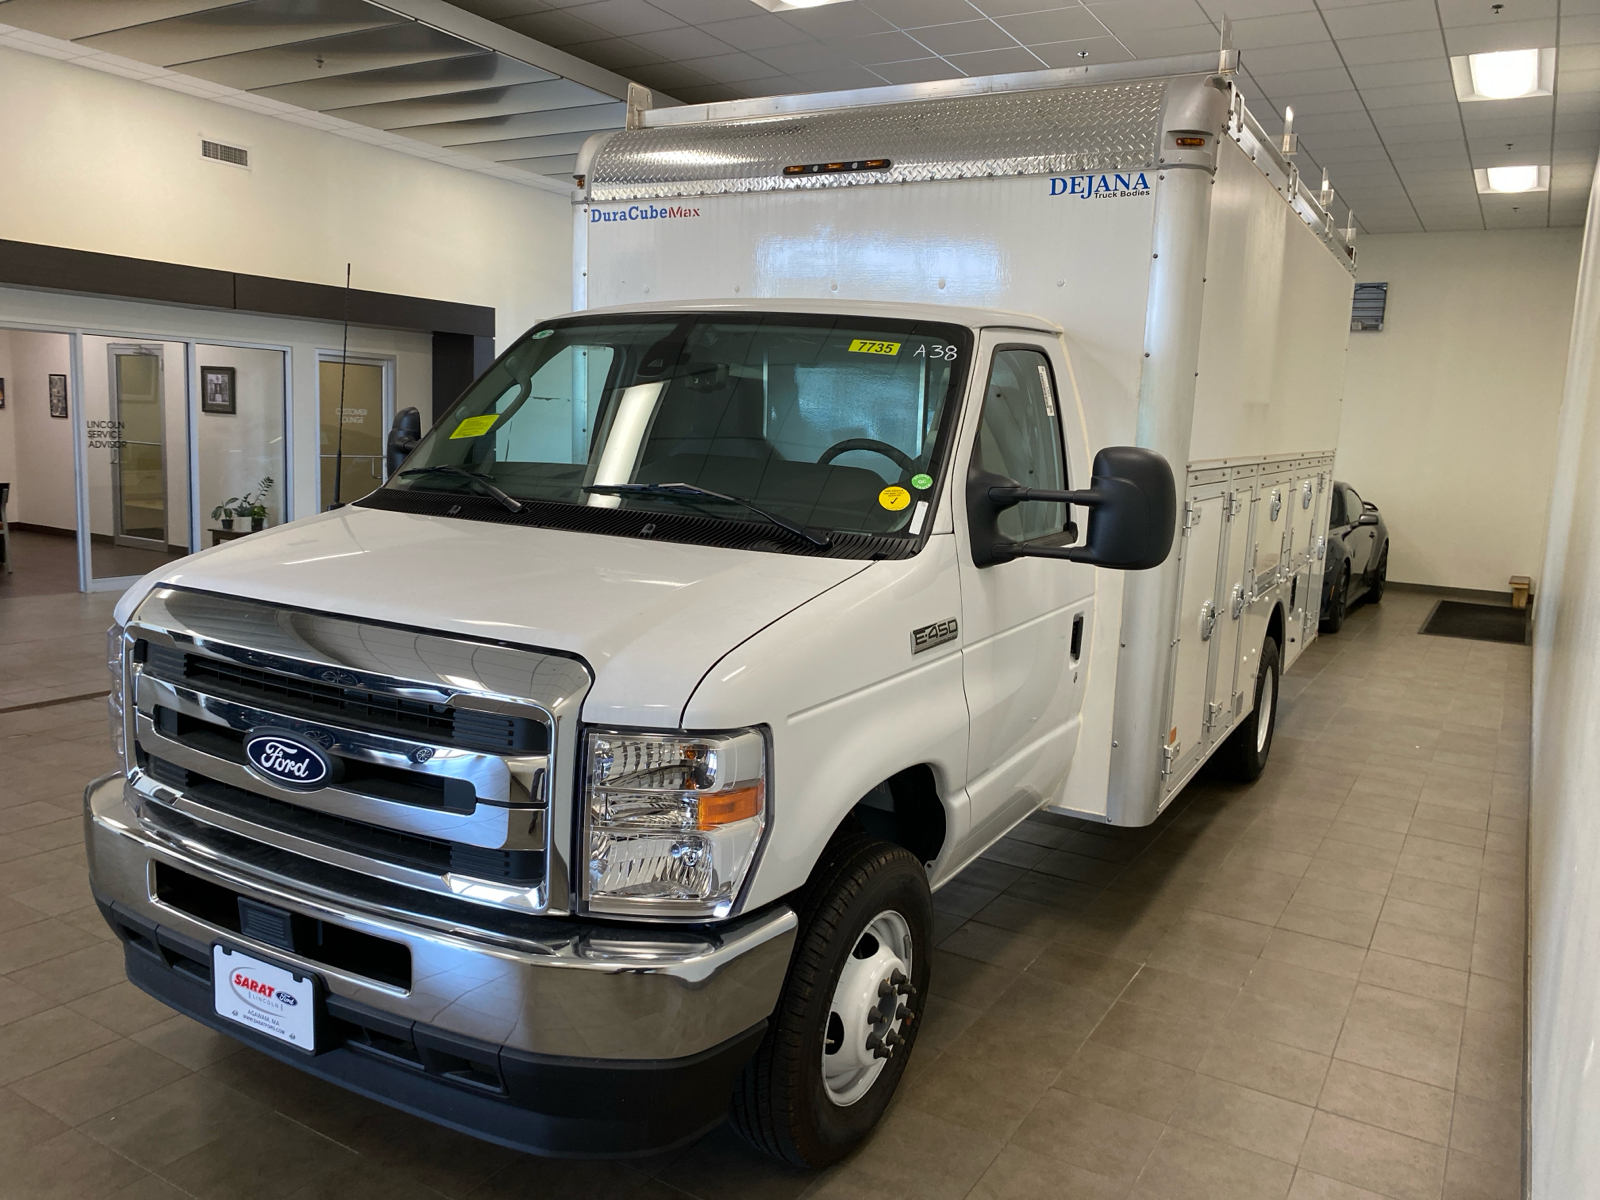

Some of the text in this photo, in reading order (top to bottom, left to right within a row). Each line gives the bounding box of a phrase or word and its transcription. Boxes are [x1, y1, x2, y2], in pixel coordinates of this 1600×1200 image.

[1049, 172, 1150, 199] DEJANA
[1094, 190, 1150, 199] Truck Bodies
[857, 341, 894, 354] 7735
[335, 407, 368, 416] CSTOMER
[86, 420, 125, 429] LINCOLN
[340, 416, 364, 424] OUNGE
[87, 430, 122, 439] SERVICE
[88, 440, 127, 449] ADVISOR
[261, 742, 309, 777] Ford
[234, 973, 295, 1005] SARAT Ford
[252, 993, 279, 1009] LINCOLN
